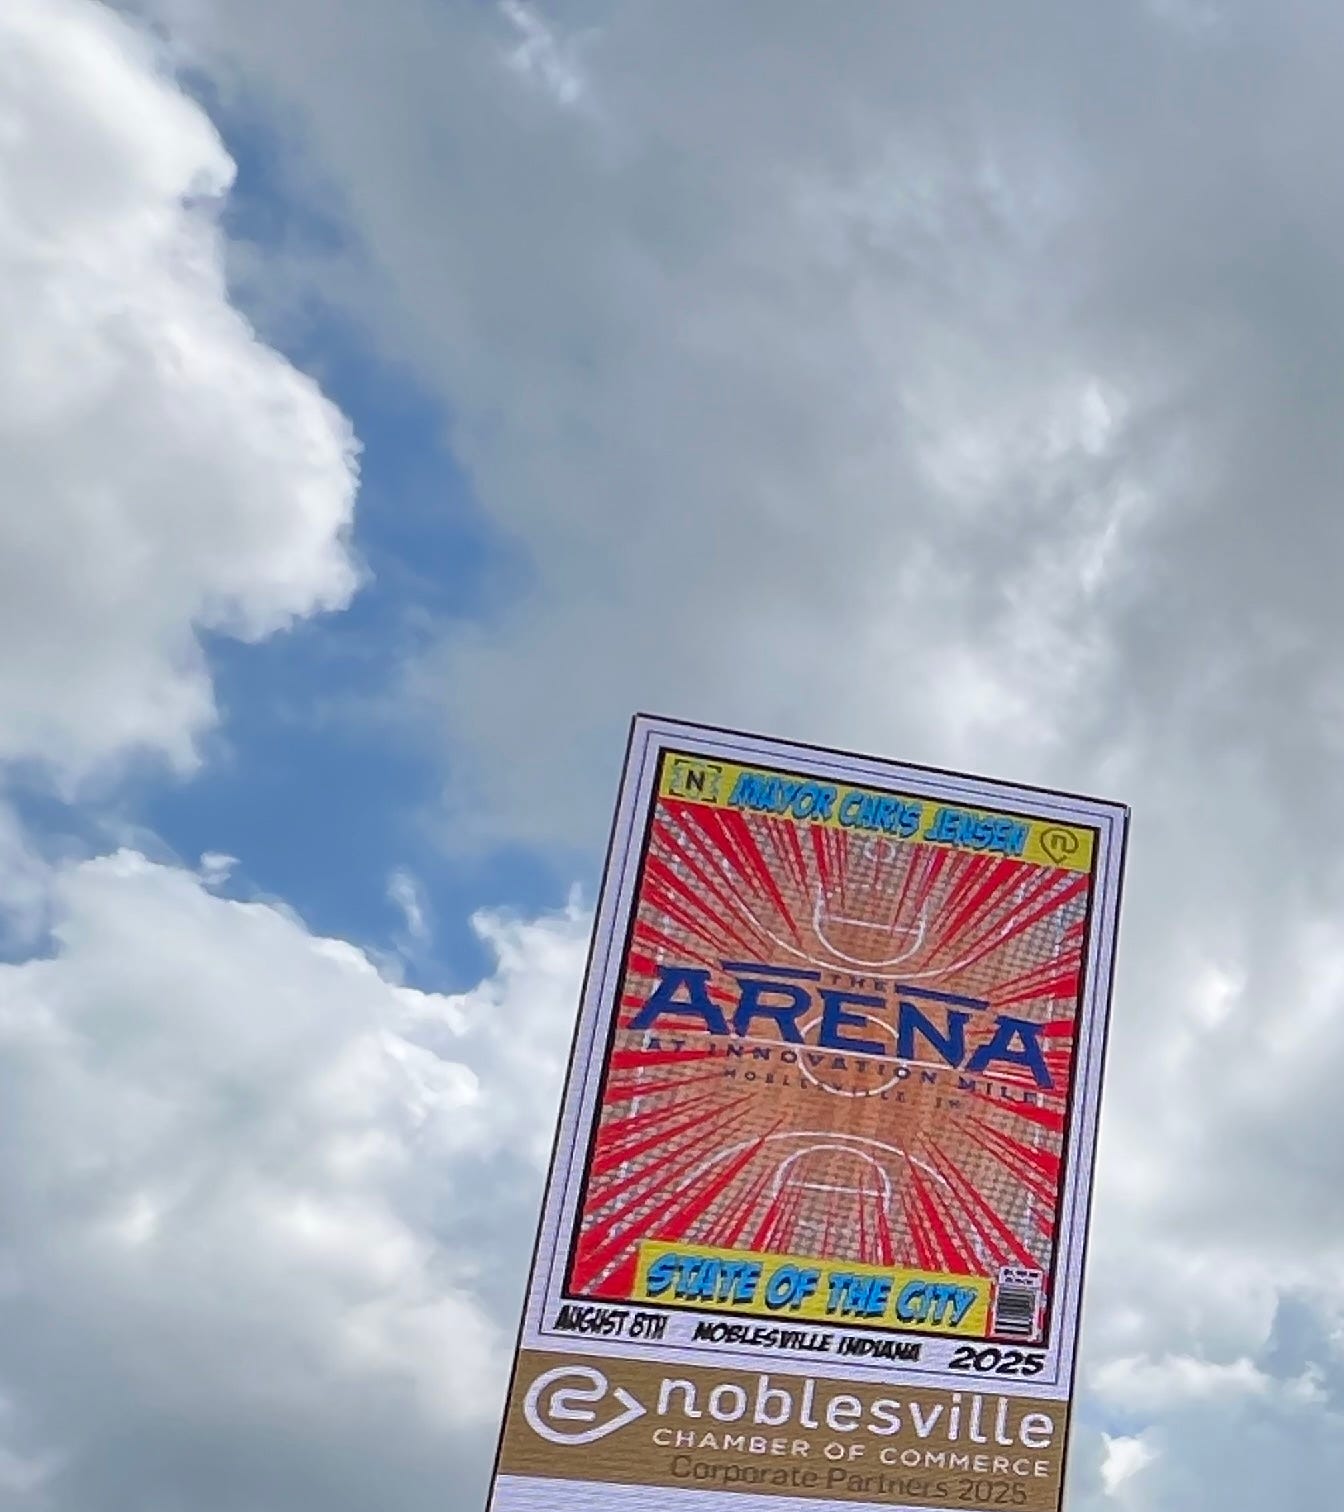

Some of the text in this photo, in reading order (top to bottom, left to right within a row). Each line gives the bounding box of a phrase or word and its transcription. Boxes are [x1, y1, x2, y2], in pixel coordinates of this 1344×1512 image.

[729, 771, 1030, 857] MAYOR CHRIS JENSEN
[830, 974, 884, 993] THE
[629, 966, 1054, 1089] ARENA
[648, 1036, 1046, 1106] AT INNOVATION MILE
[645, 1253, 978, 1326] STATE OF THE CITY
[554, 1304, 1047, 1376] AUGUST 8TH NOBLESVILLE INDIANA 2025
[657, 1375, 1056, 1450] noblesville
[652, 1427, 1051, 1478] CHAMBER OF COMMERCE
[669, 1455, 1027, 1506] Corporate Partners 2025
